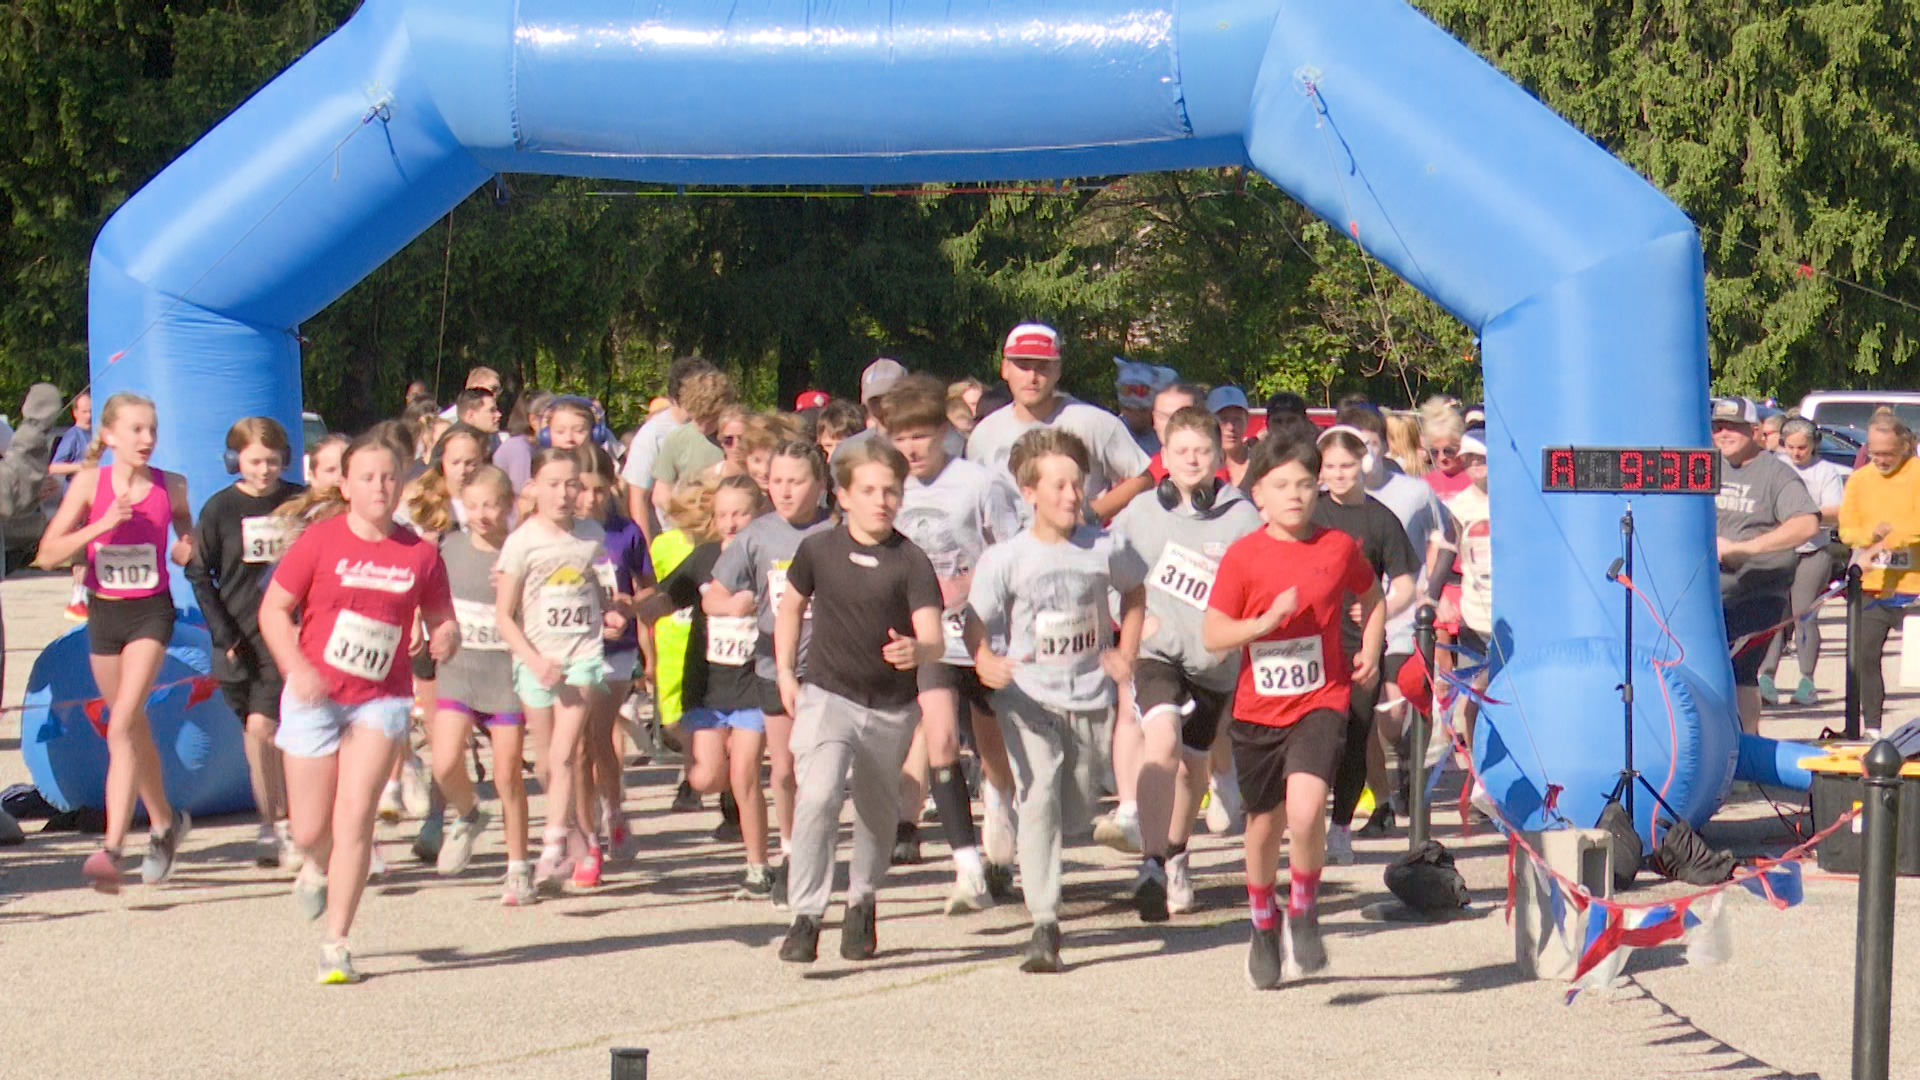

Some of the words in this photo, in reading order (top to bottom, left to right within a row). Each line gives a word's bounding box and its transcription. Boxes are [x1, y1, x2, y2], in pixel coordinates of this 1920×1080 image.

[1619, 450, 1712, 491] 9:30
[104, 563, 152, 584] 3107
[1160, 564, 1208, 601] 3110
[1259, 659, 1319, 690] 3280
